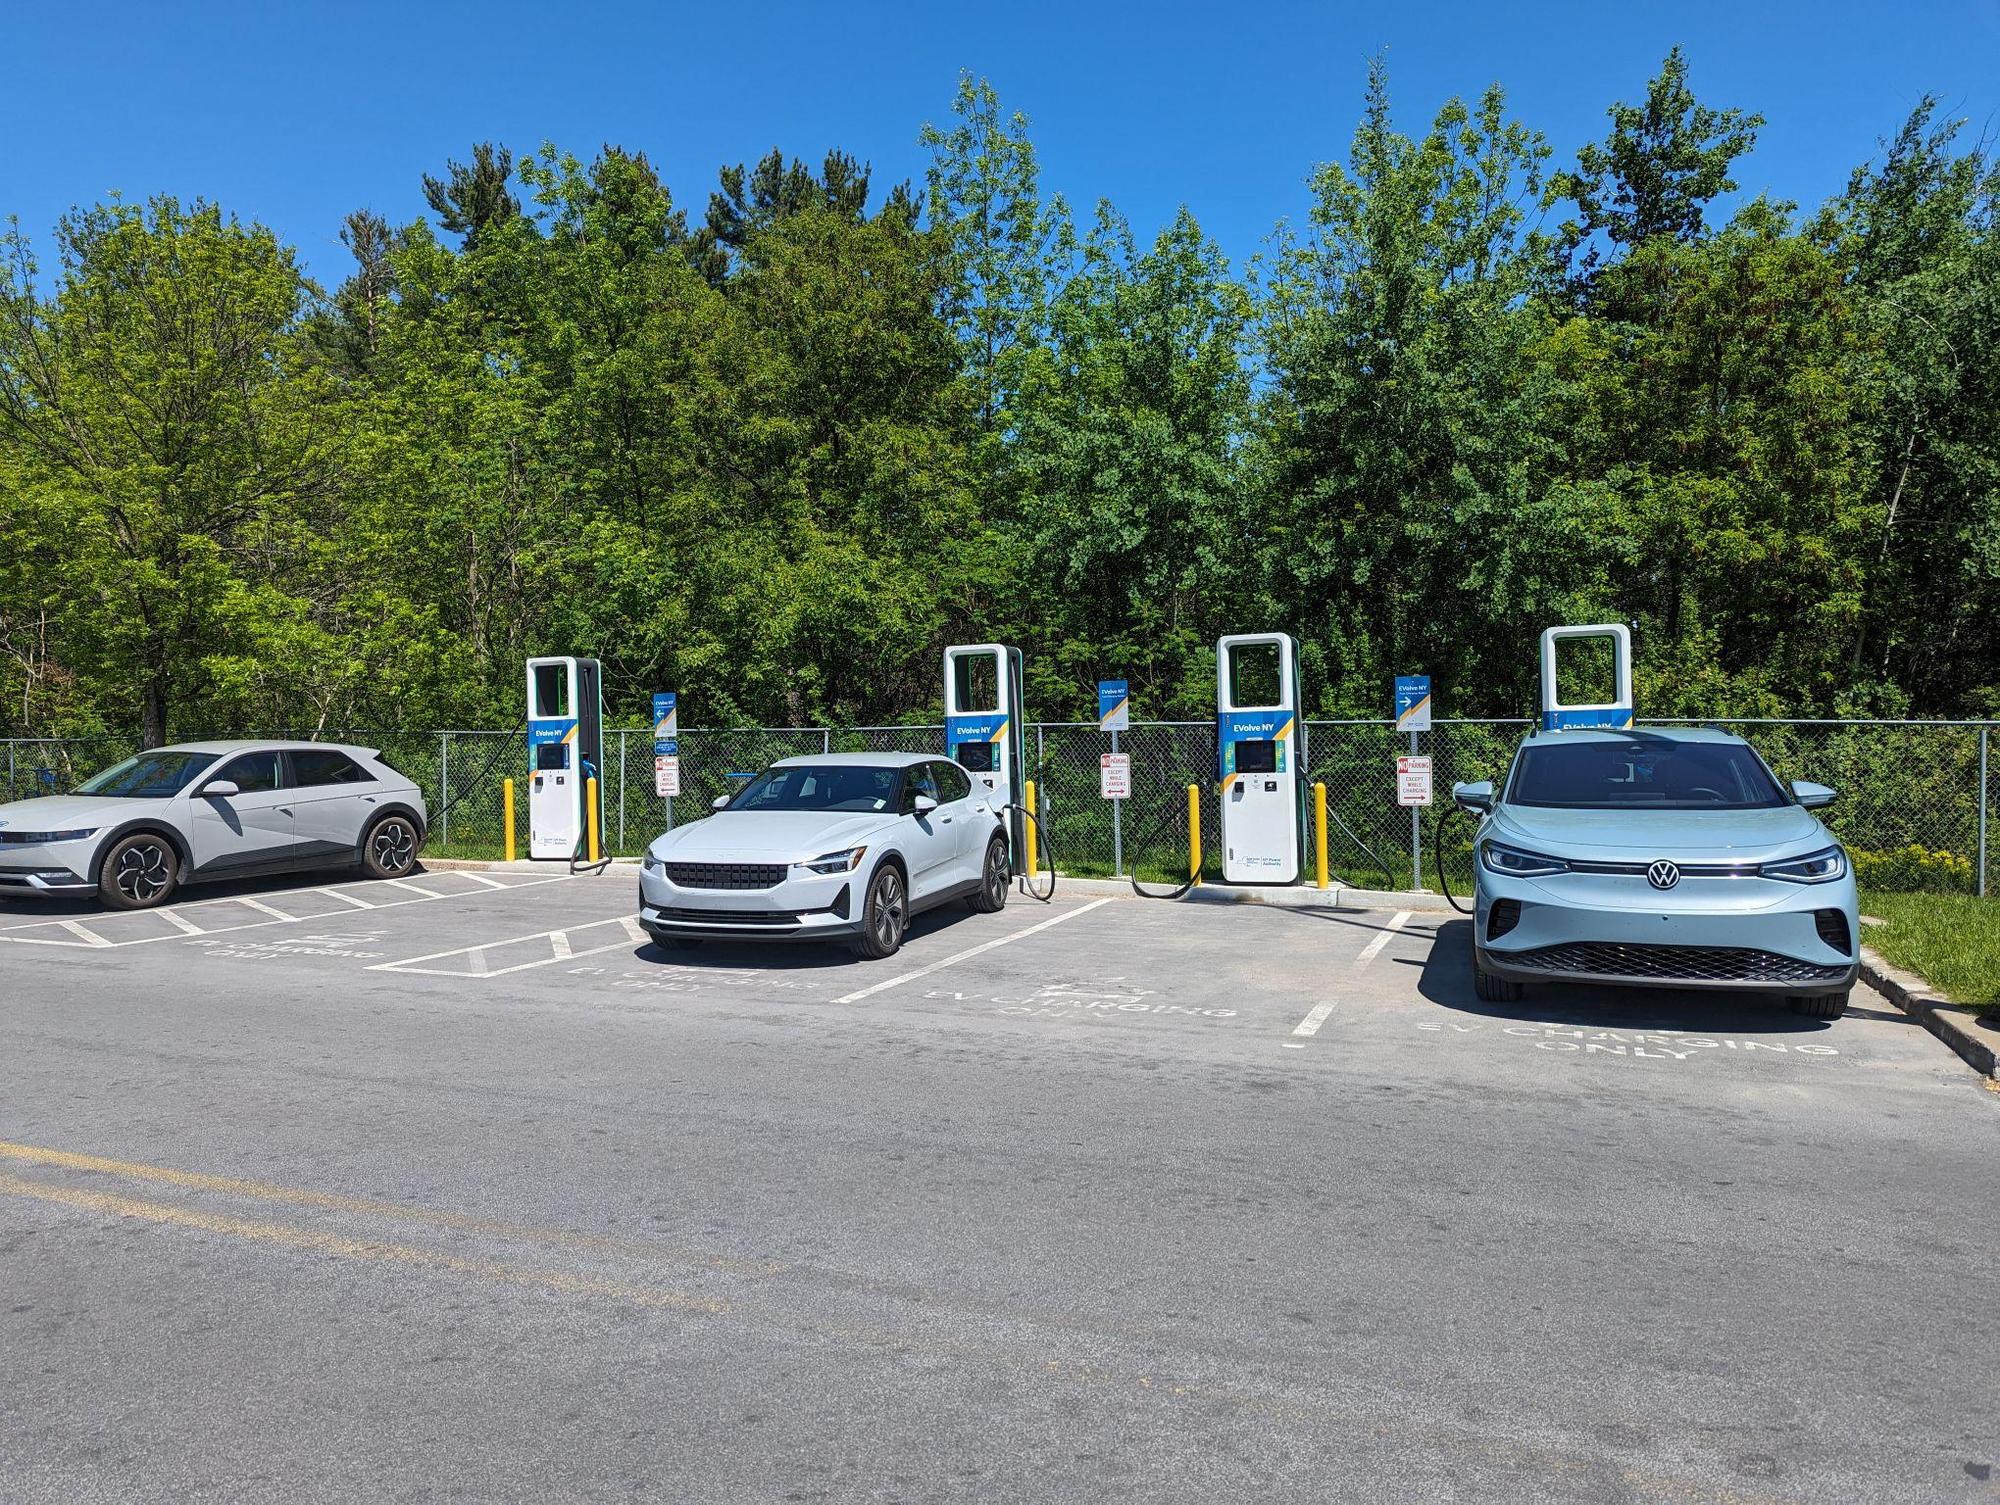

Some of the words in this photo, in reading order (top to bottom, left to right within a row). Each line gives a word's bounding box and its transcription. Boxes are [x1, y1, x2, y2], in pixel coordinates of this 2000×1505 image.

[1233, 724, 1261, 732] EVolve
[1262, 723, 1274, 731] NY
[1648, 860, 1680, 889] VW
[999, 1006, 1120, 1018] ONY
[1417, 1022, 1481, 1032] EV
[1502, 1027, 1840, 1055] CHARGING
[1536, 1041, 1698, 1059] ONLY
